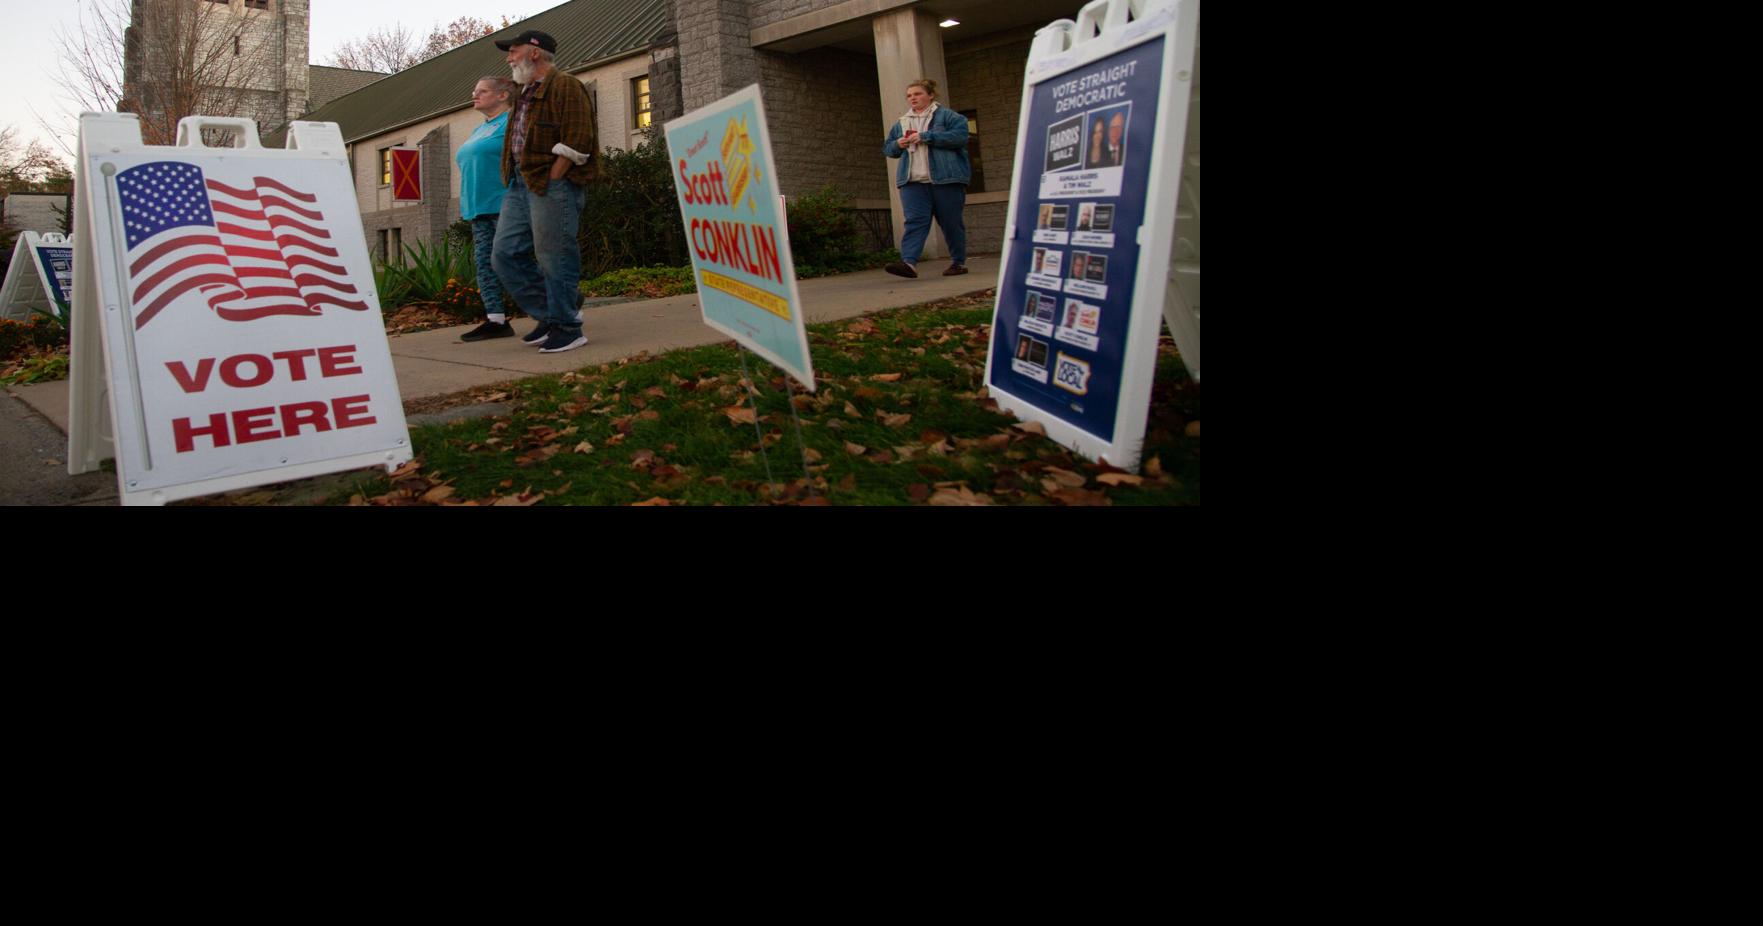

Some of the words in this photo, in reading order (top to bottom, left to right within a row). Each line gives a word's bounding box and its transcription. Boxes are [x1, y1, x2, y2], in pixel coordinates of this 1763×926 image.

[1052, 80, 1077, 98] VOTE
[1078, 61, 1137, 91] STRAIGHT
[1055, 82, 1127, 113] DEMOCRATIC
[1050, 125, 1080, 152] HARRIS
[1052, 147, 1073, 162] WALZ
[679, 158, 728, 205] Scott
[691, 218, 783, 285] CONKLIN
[165, 345, 363, 393] VOTE
[172, 394, 377, 453] HERE
